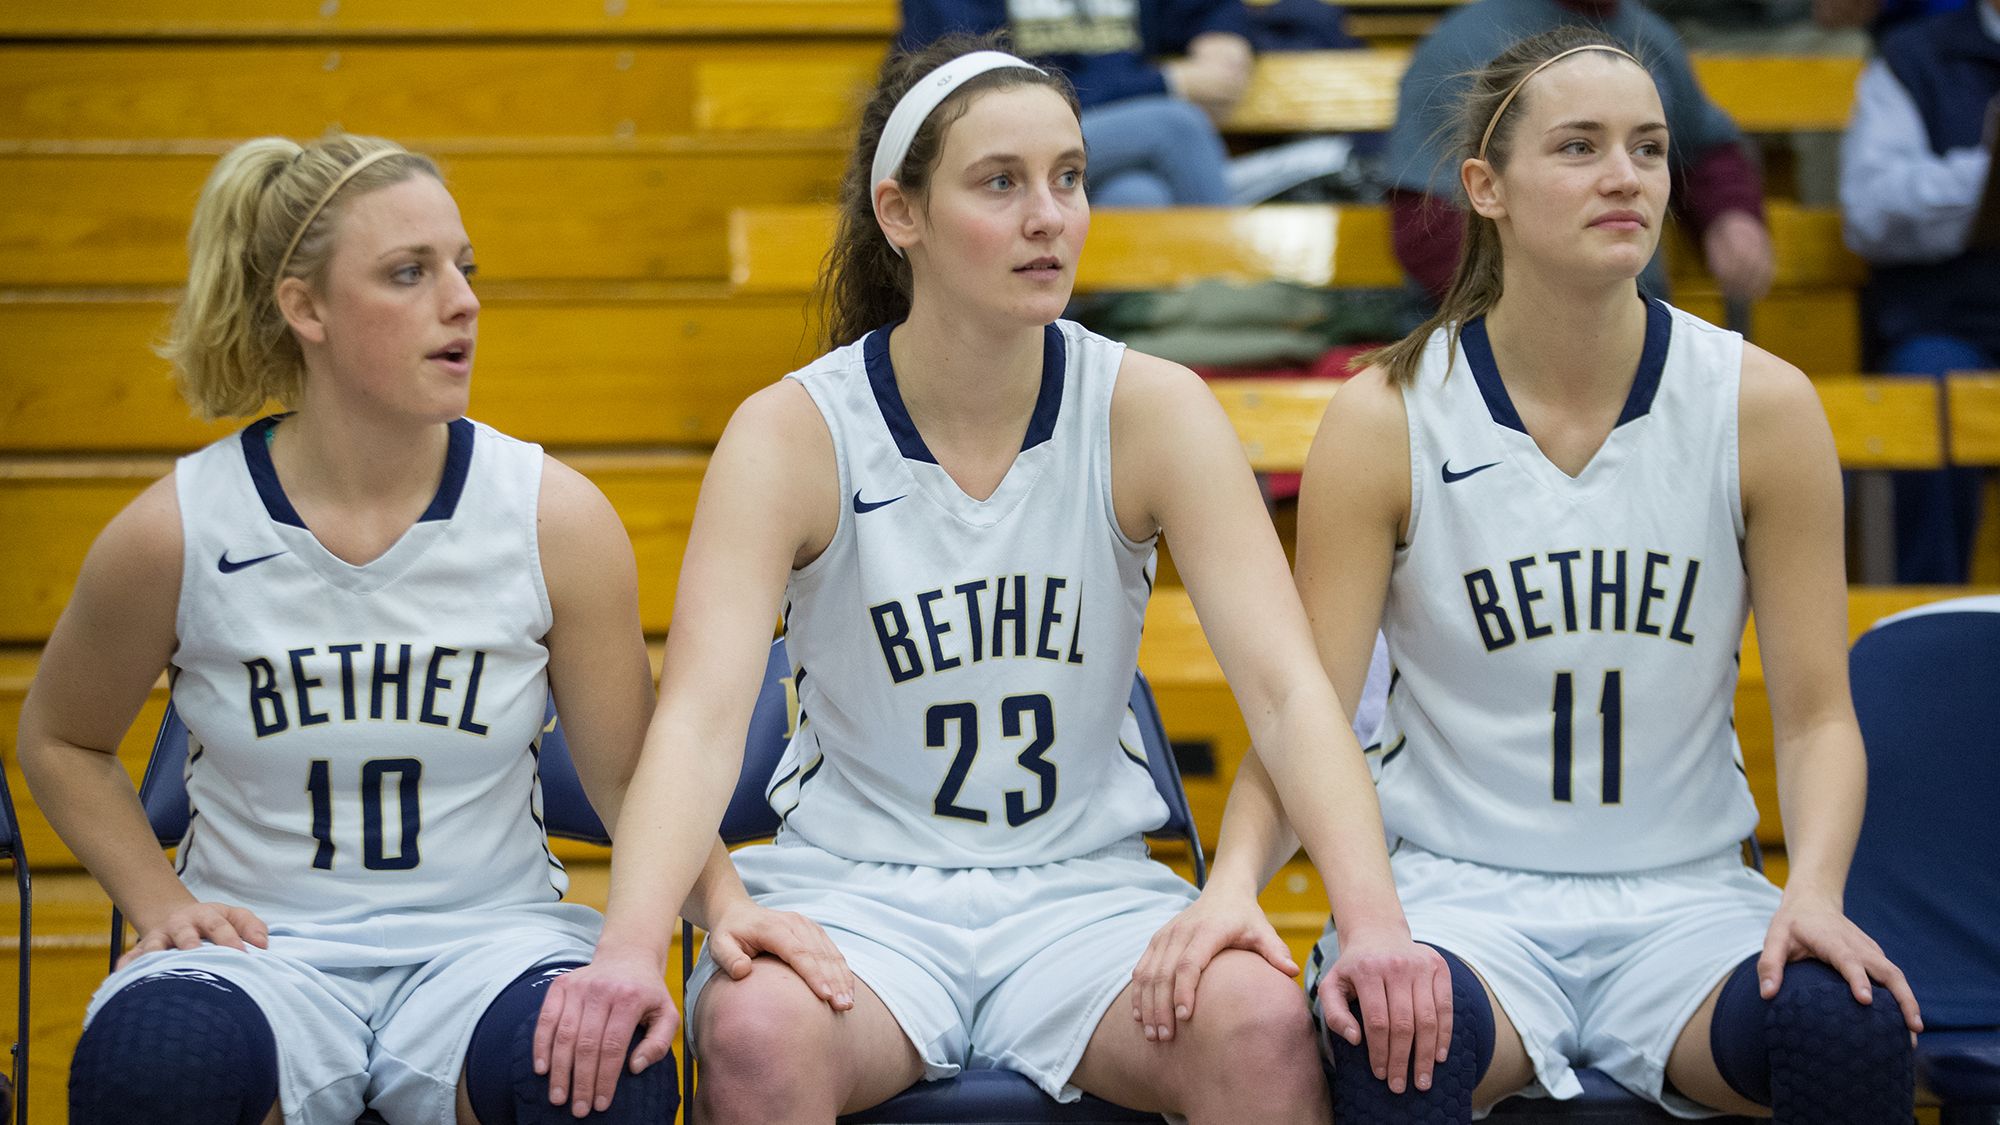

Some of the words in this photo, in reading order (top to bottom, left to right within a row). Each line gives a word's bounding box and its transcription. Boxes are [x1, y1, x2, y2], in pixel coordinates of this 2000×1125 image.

[1463, 548, 1701, 653] BETHEL
[243, 642, 490, 739] BETHEL
[1551, 668, 1624, 806] 11
[306, 756, 424, 871] 10
[924, 691, 1058, 828] 23
